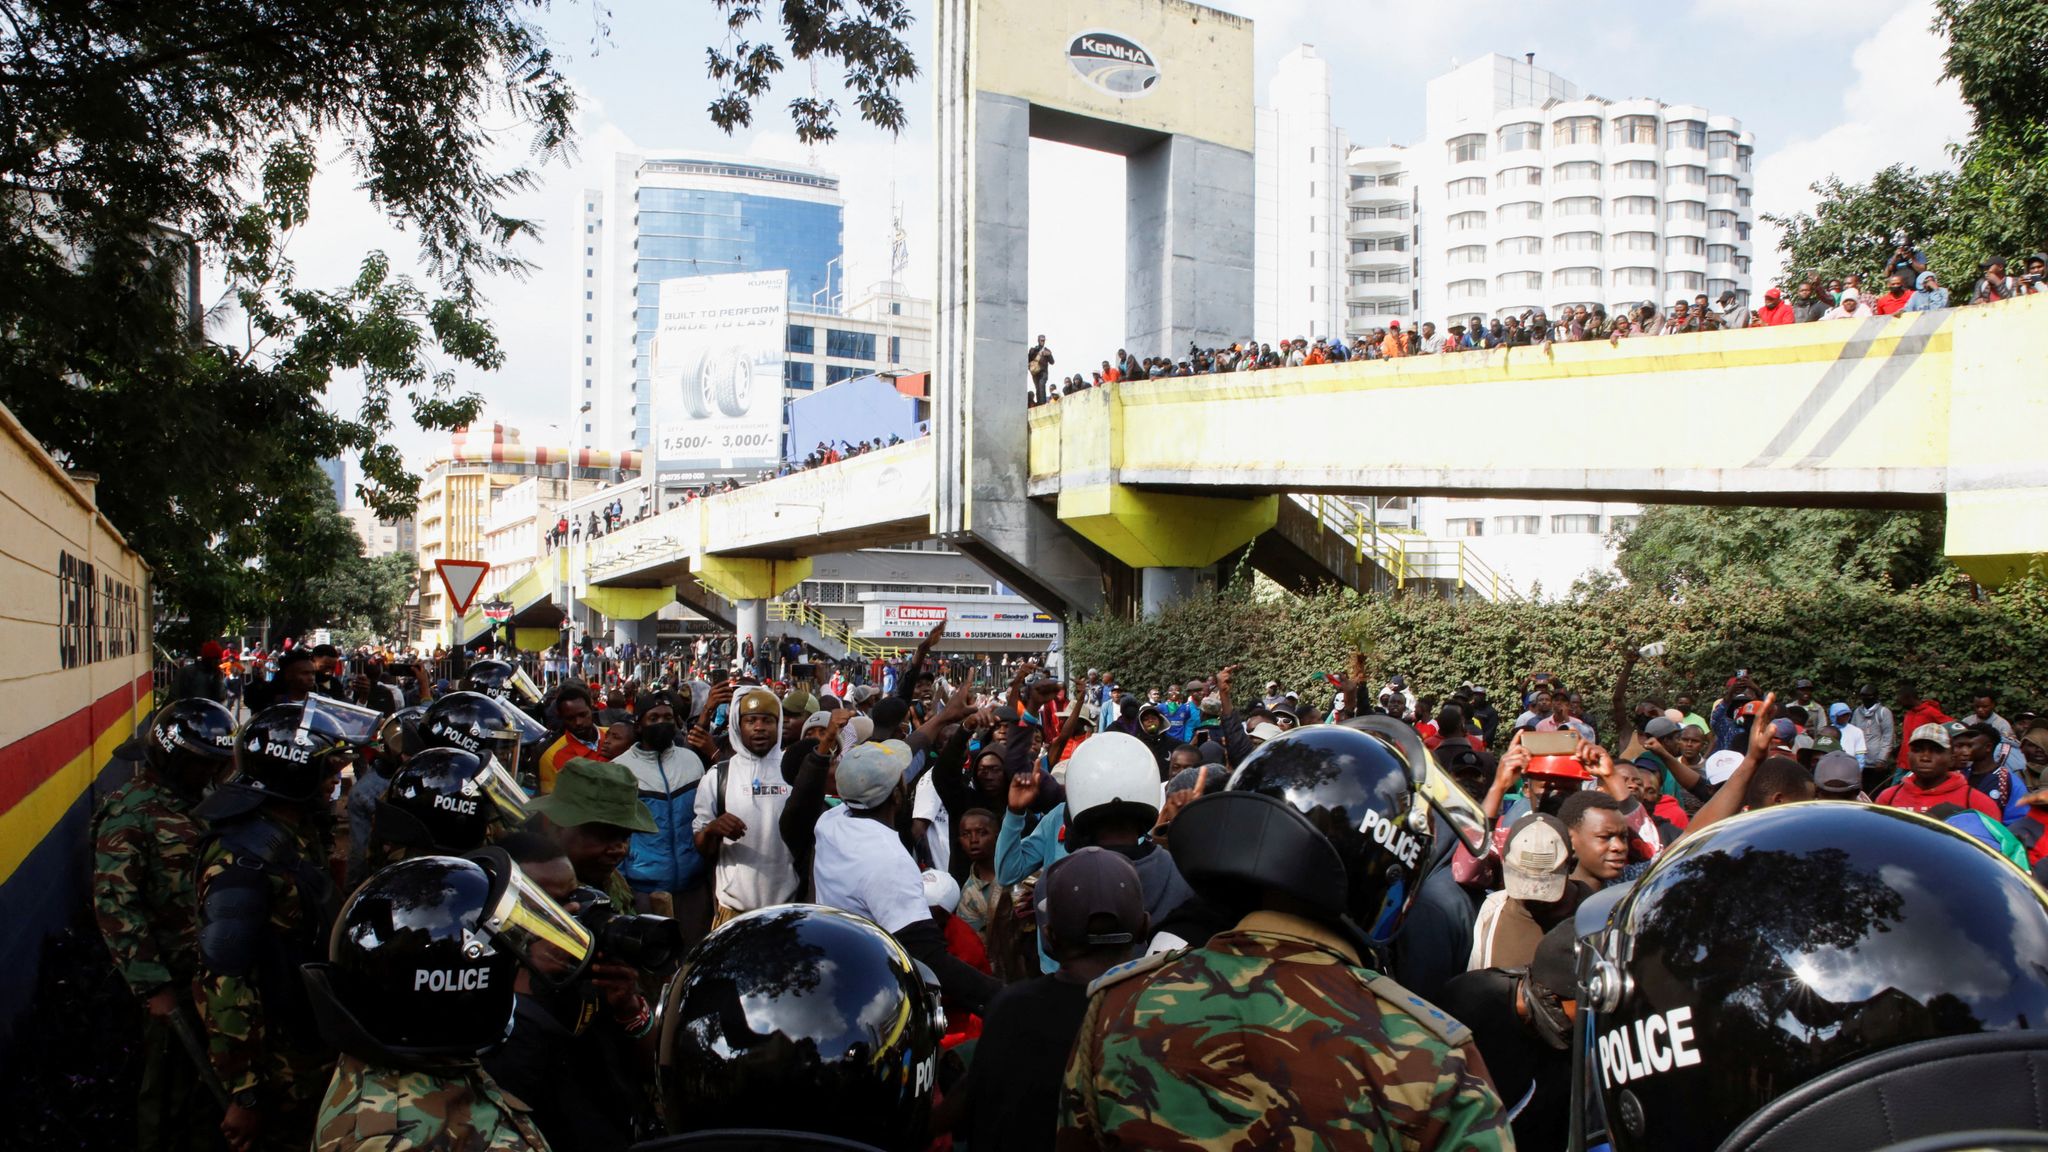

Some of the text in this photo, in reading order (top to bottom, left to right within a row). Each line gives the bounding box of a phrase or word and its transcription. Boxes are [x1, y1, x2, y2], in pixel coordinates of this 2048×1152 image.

[1081, 37, 1147, 65] KeNHA
[664, 305, 780, 320] BUILT TO PERFORM
[663, 433, 774, 450] 1,500/- 3,000/-
[900, 608, 947, 618] KINGSWAY
[487, 688, 511, 699] POLICE
[154, 724, 175, 753] POLICE
[443, 726, 480, 753] POLICE
[265, 742, 310, 764] POLICE
[433, 795, 477, 815] POLICE
[1358, 808, 1421, 870] POLICE
[414, 967, 491, 992] POLICE
[1598, 1005, 1702, 1090] POLICE
